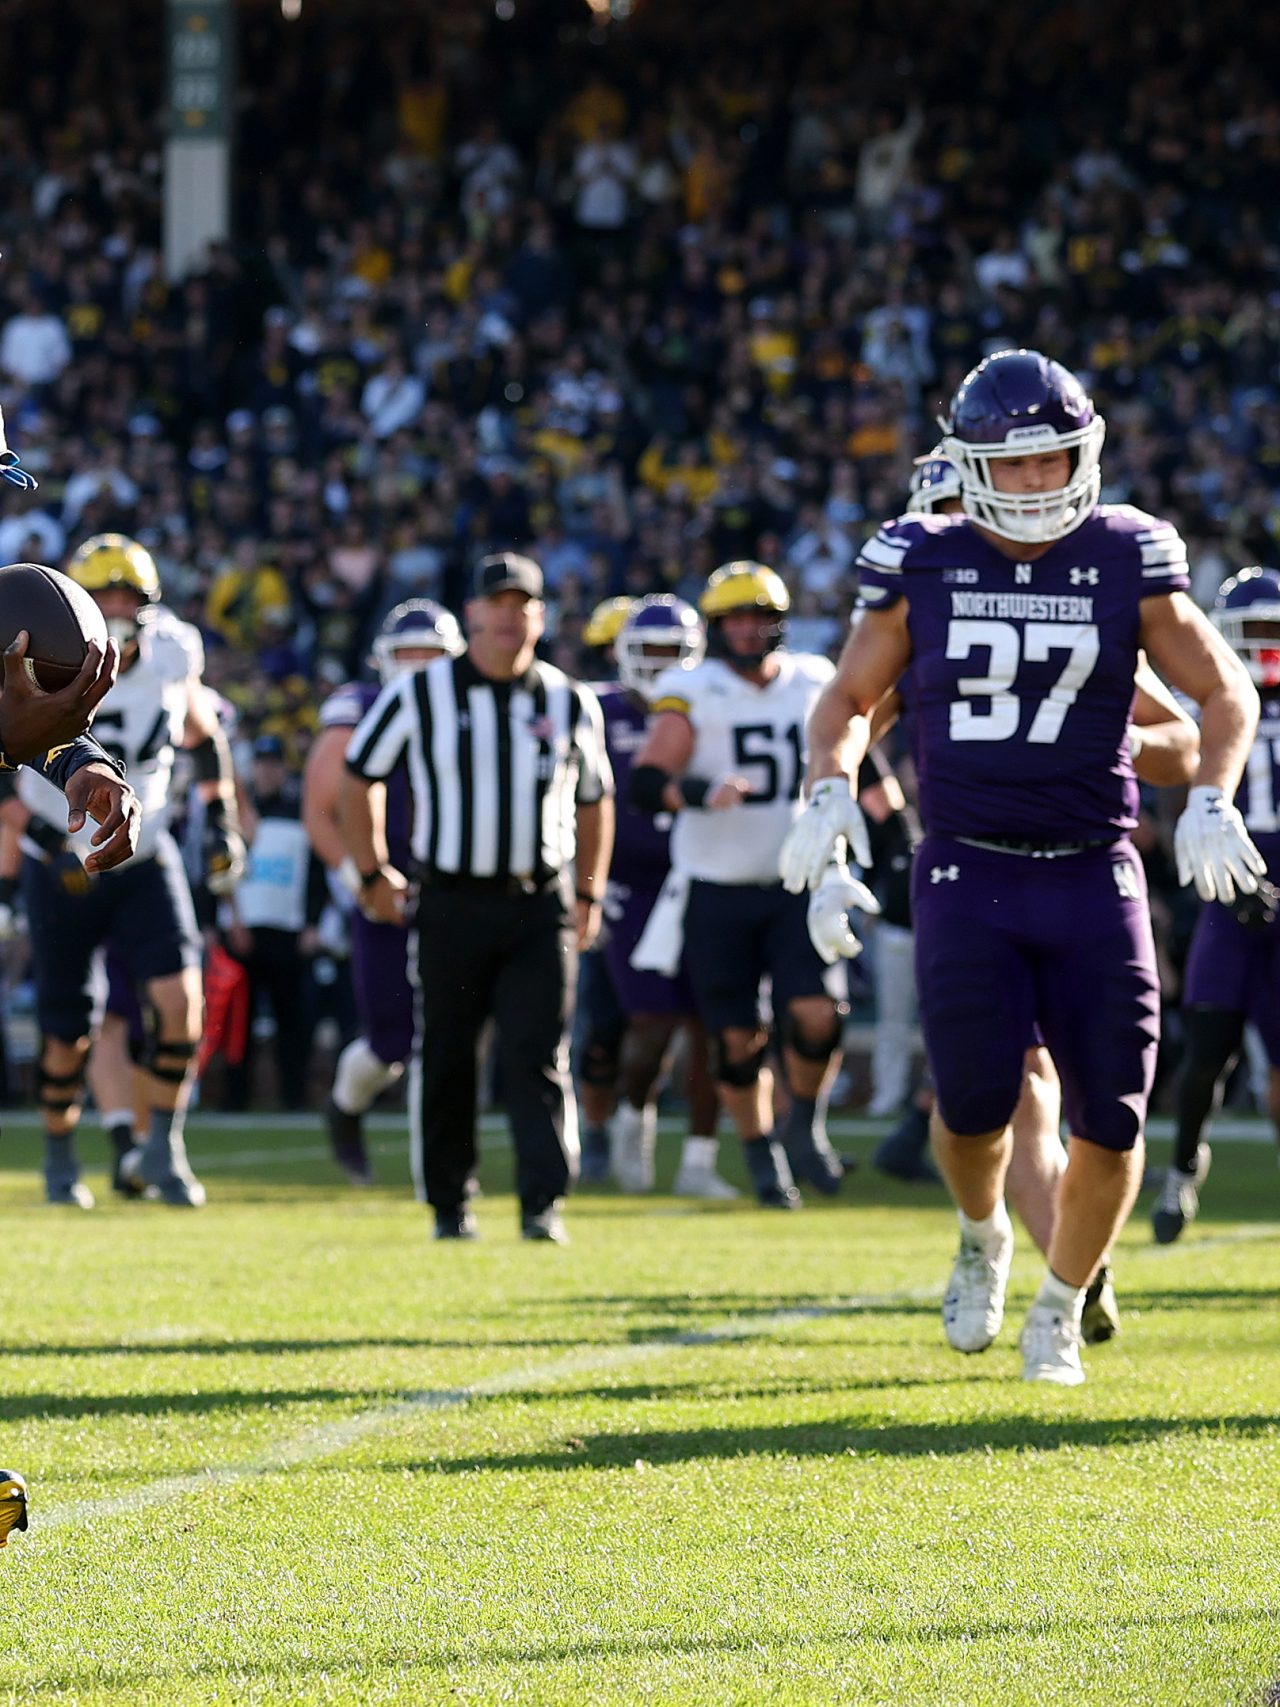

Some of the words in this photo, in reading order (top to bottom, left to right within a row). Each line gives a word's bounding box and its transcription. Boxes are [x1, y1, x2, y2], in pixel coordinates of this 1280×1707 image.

[1015, 563, 1032, 584] N
[951, 591, 1093, 622] NORTHWESTERN
[945, 619, 1100, 744] 37
[732, 722, 805, 804] 51
